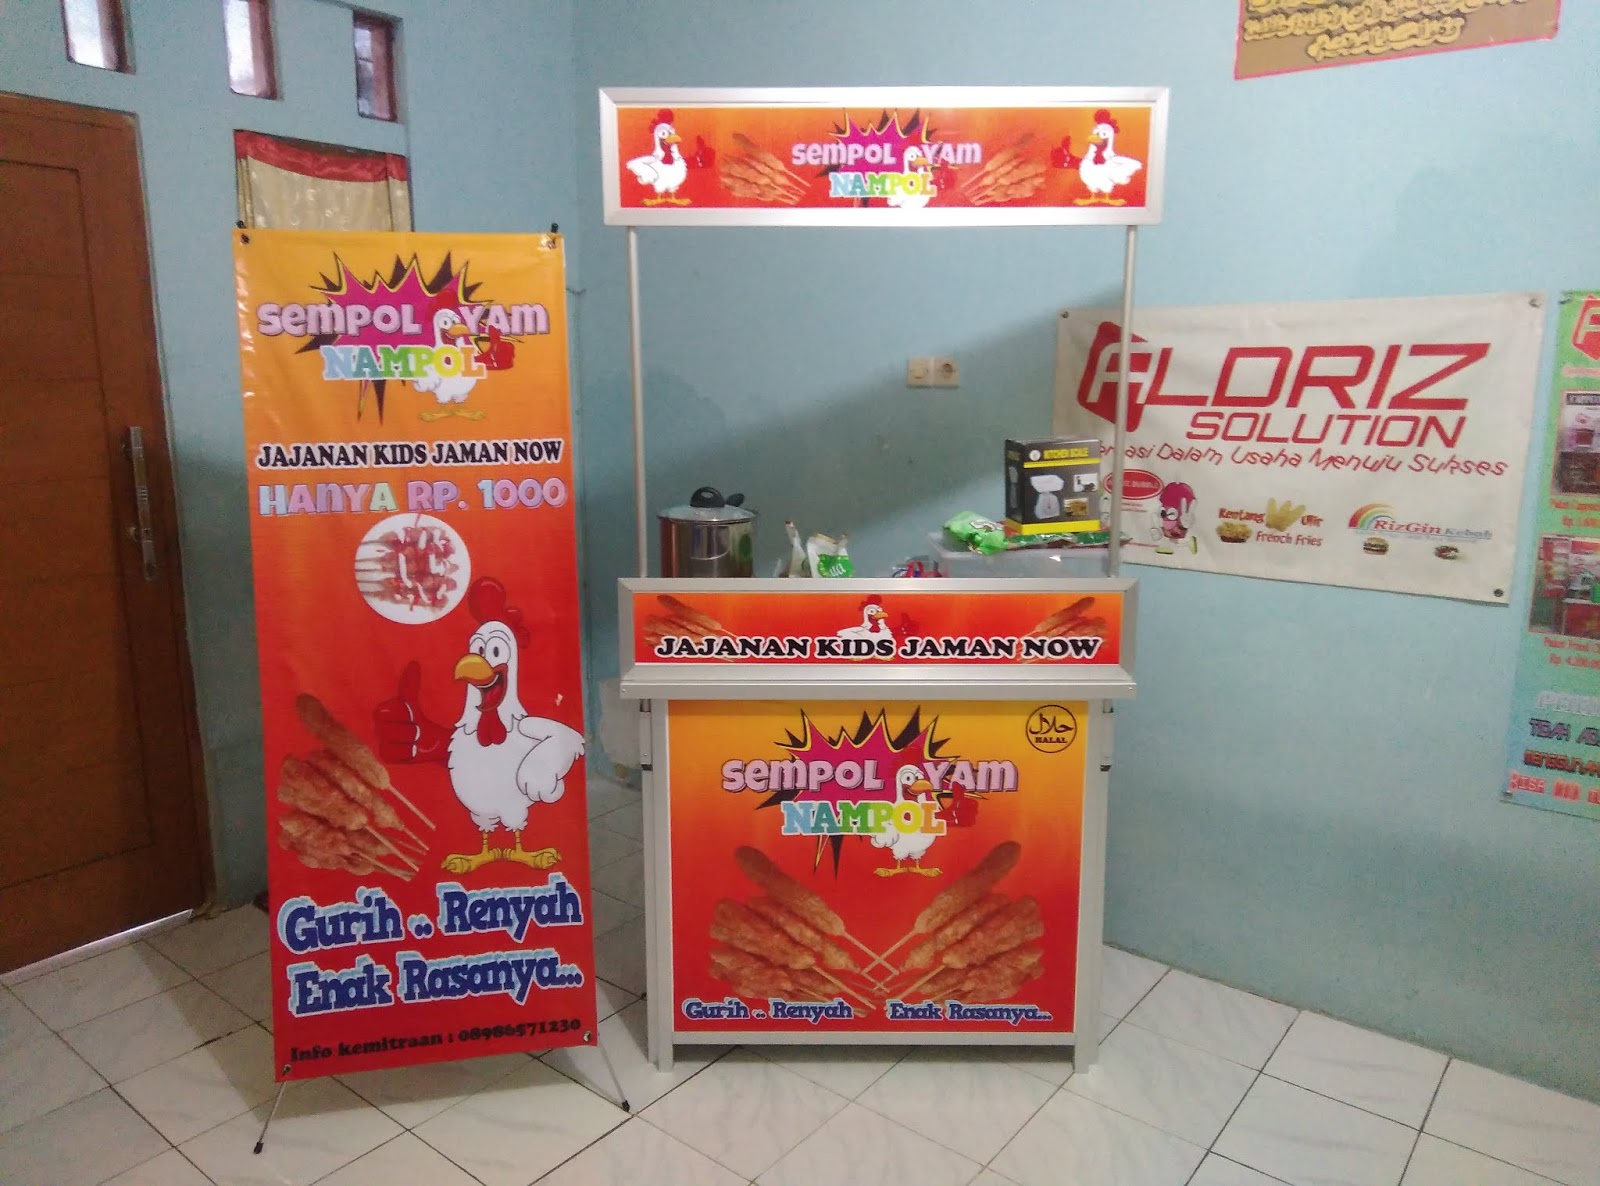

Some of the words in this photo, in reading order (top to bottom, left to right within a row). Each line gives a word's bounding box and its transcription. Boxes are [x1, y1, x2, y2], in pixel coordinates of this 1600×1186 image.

[829, 172, 937, 198] NAMPOL
[320, 344, 487, 380] NAMPOL
[1186, 411, 1466, 448] SOLUTION
[256, 443, 368, 468] JAJANAN
[372, 442, 428, 467] KIDS
[431, 440, 510, 465] JAMAN
[511, 438, 564, 463] NOW
[1157, 443, 1223, 465] Dalam
[1231, 445, 1301, 470] Usaha
[1308, 447, 1398, 473] Menuju
[1408, 453, 1508, 477] Sukses
[406, 480, 469, 512] RP.
[476, 477, 568, 509] 1000
[1218, 507, 1265, 523] Kentang
[1374, 520, 1441, 535] RizGin
[1255, 531, 1293, 544] French
[1295, 535, 1323, 547] Fries
[655, 636, 811, 660] JAJANAN
[812, 636, 897, 660] KIDS
[898, 636, 1018, 659] JAMAN
[1020, 636, 1103, 660] NOW
[1029, 713, 1074, 735] حلال
[780, 799, 947, 836] NAMPOL
[277, 886, 404, 954] Gurih
[435, 872, 584, 943] Renyah
[287, 954, 394, 1017] Enak
[396, 948, 584, 1006] Rasanya...
[683, 997, 751, 1021] Gurih
[768, 997, 854, 1025] Renyah
[886, 998, 943, 1021] Enak
[945, 1000, 1053, 1026] Rasanya...
[290, 1044, 333, 1063] Info
[337, 1032, 443, 1058] kemitraan
